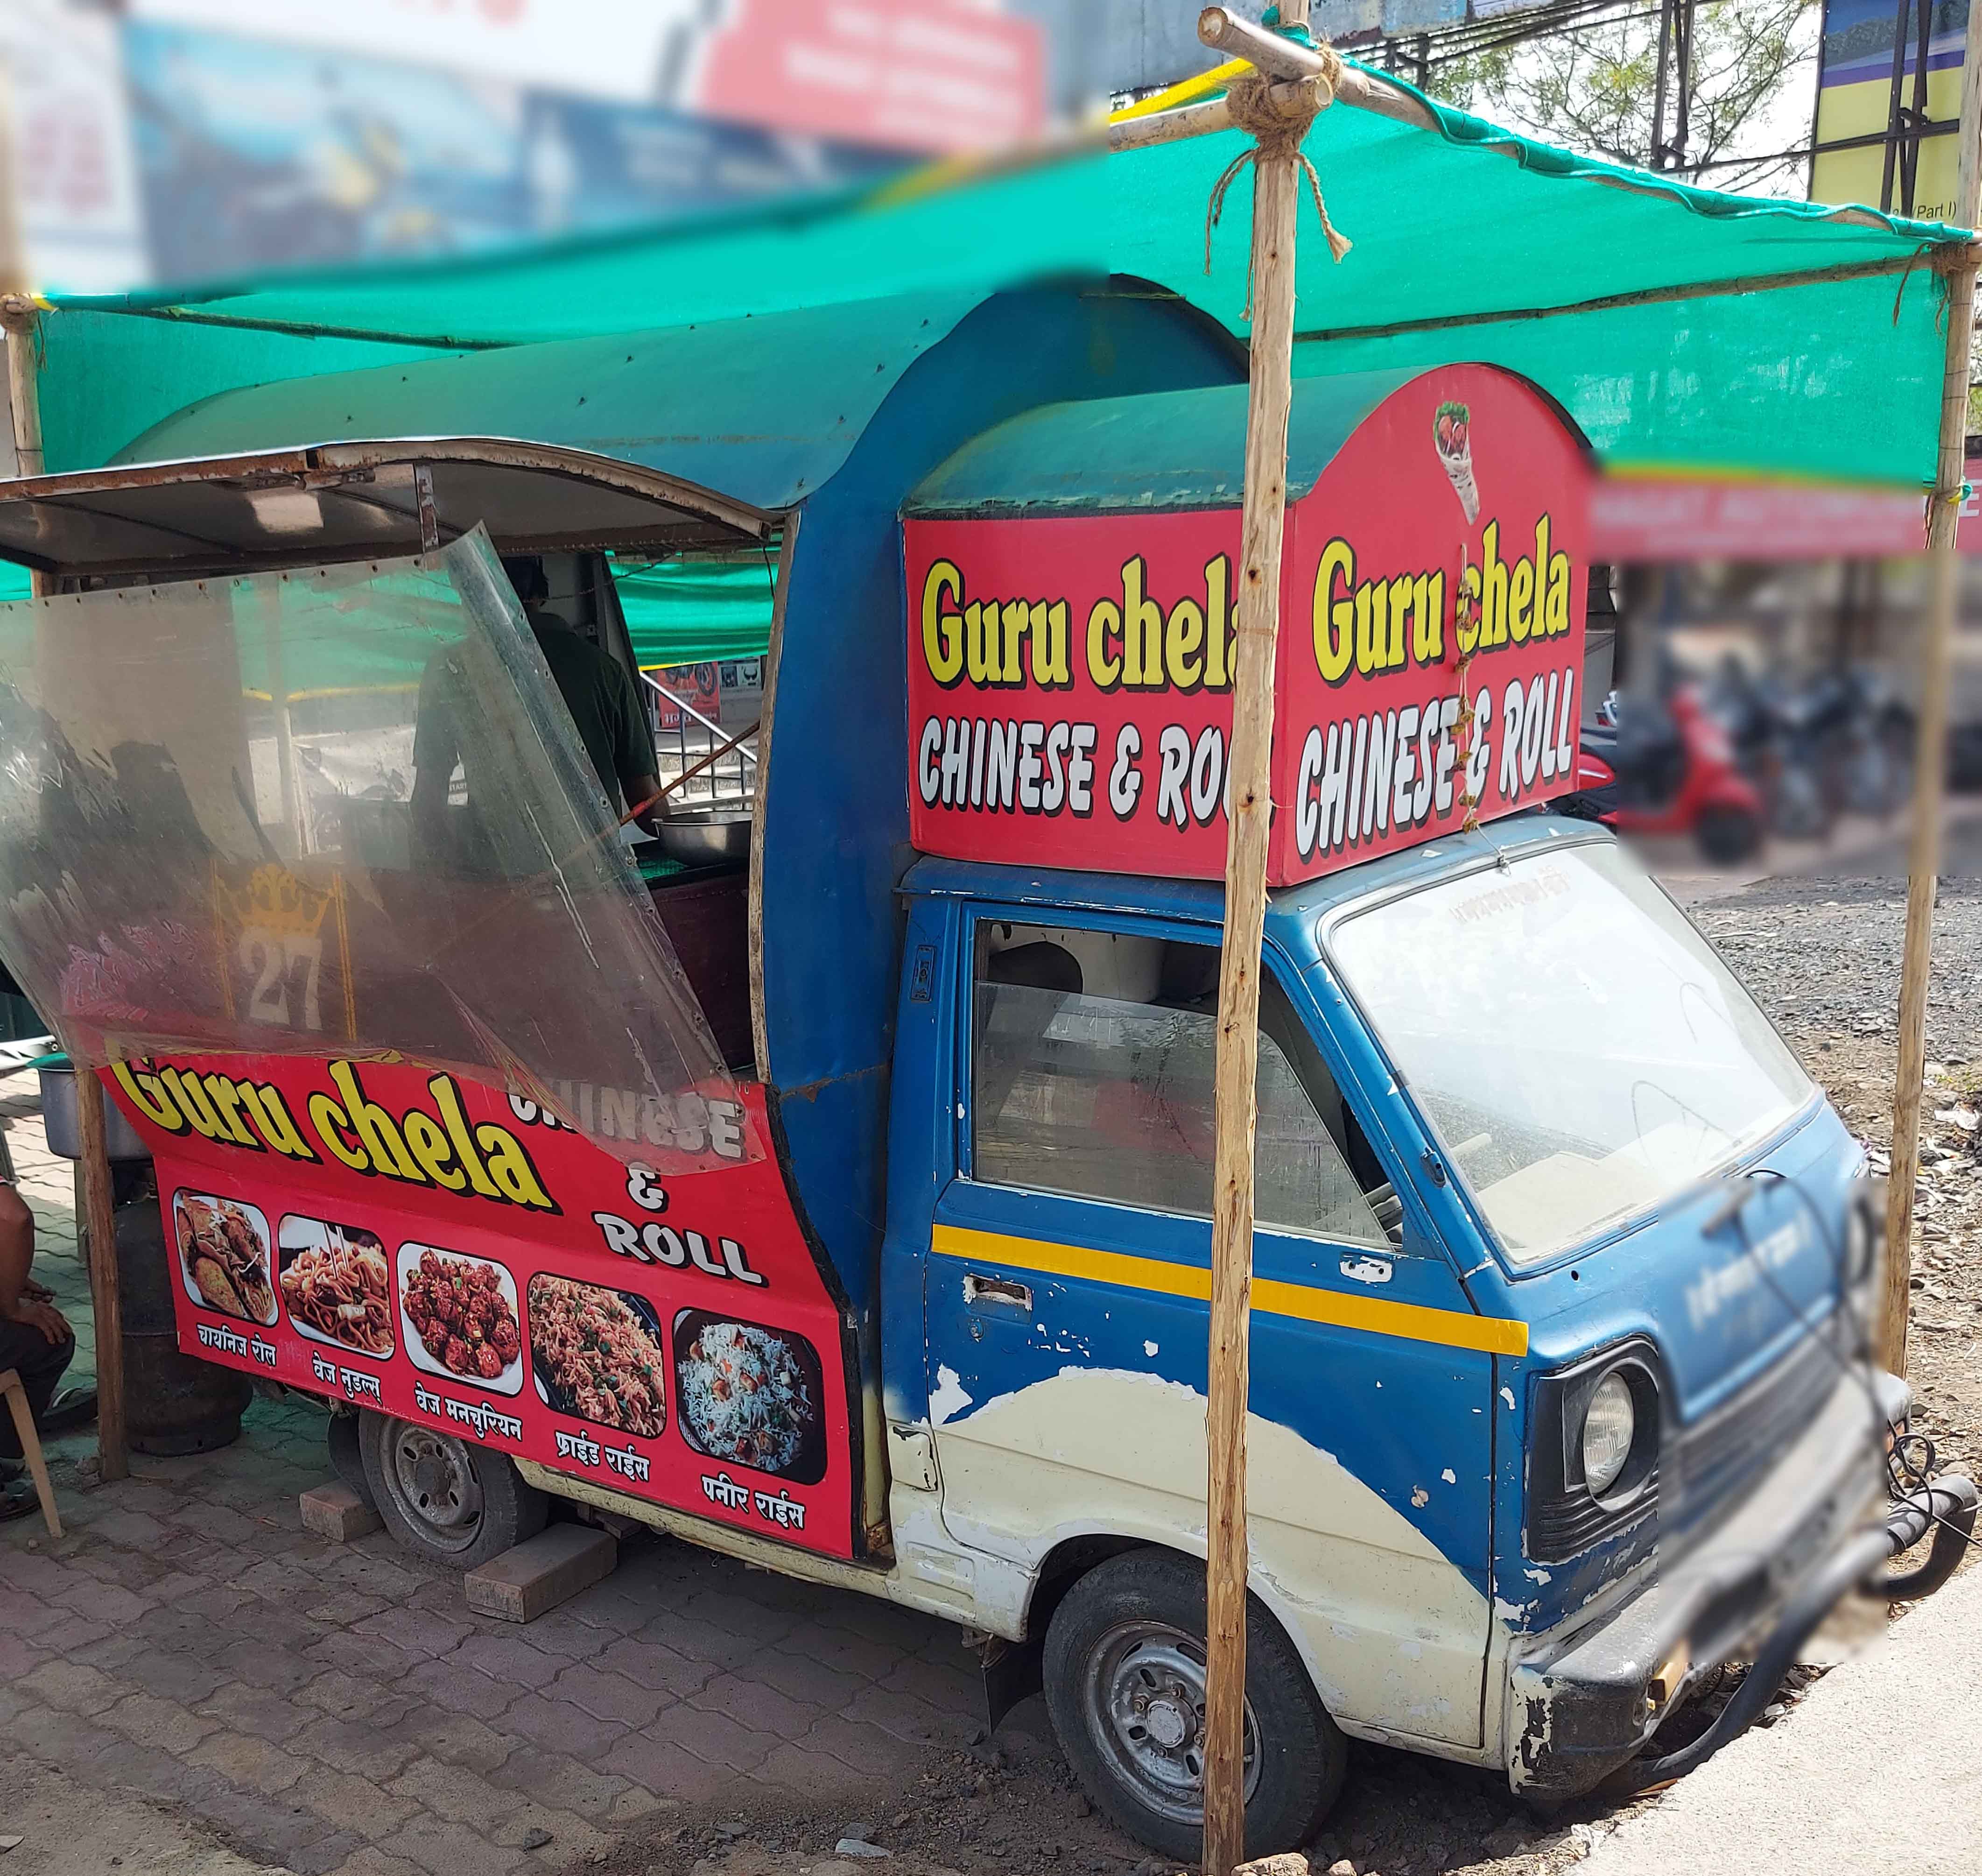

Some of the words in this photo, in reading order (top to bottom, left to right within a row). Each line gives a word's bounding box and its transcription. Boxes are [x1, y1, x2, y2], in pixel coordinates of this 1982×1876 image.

[921, 557, 1075, 691] Guru
[1087, 552, 1240, 695] chel
[1312, 536, 1445, 688] Guru
[1455, 511, 1571, 655] chela
[919, 716, 1100, 817] CHINESE
[1109, 723, 1143, 825] &
[1157, 724, 1237, 833] RO
[1295, 695, 1462, 865] CHINESE
[1499, 666, 1574, 804] ROLL
[239, 931, 323, 1030] 27
[106, 1047, 323, 1164] Guru
[308, 1058, 563, 1215] chela
[626, 1161, 669, 1213] &
[591, 1211, 769, 1287] ROLL
[196, 1322, 248, 1358] चायनिज
[250, 1332, 276, 1366] रोल
[312, 1350, 337, 1385] वेज
[415, 1381, 442, 1417] वेज
[444, 1397, 522, 1442] मनचुरियन
[605, 1445, 650, 1481] राईस
[702, 1472, 749, 1513] पनीर
[754, 1488, 805, 1530] राईस
